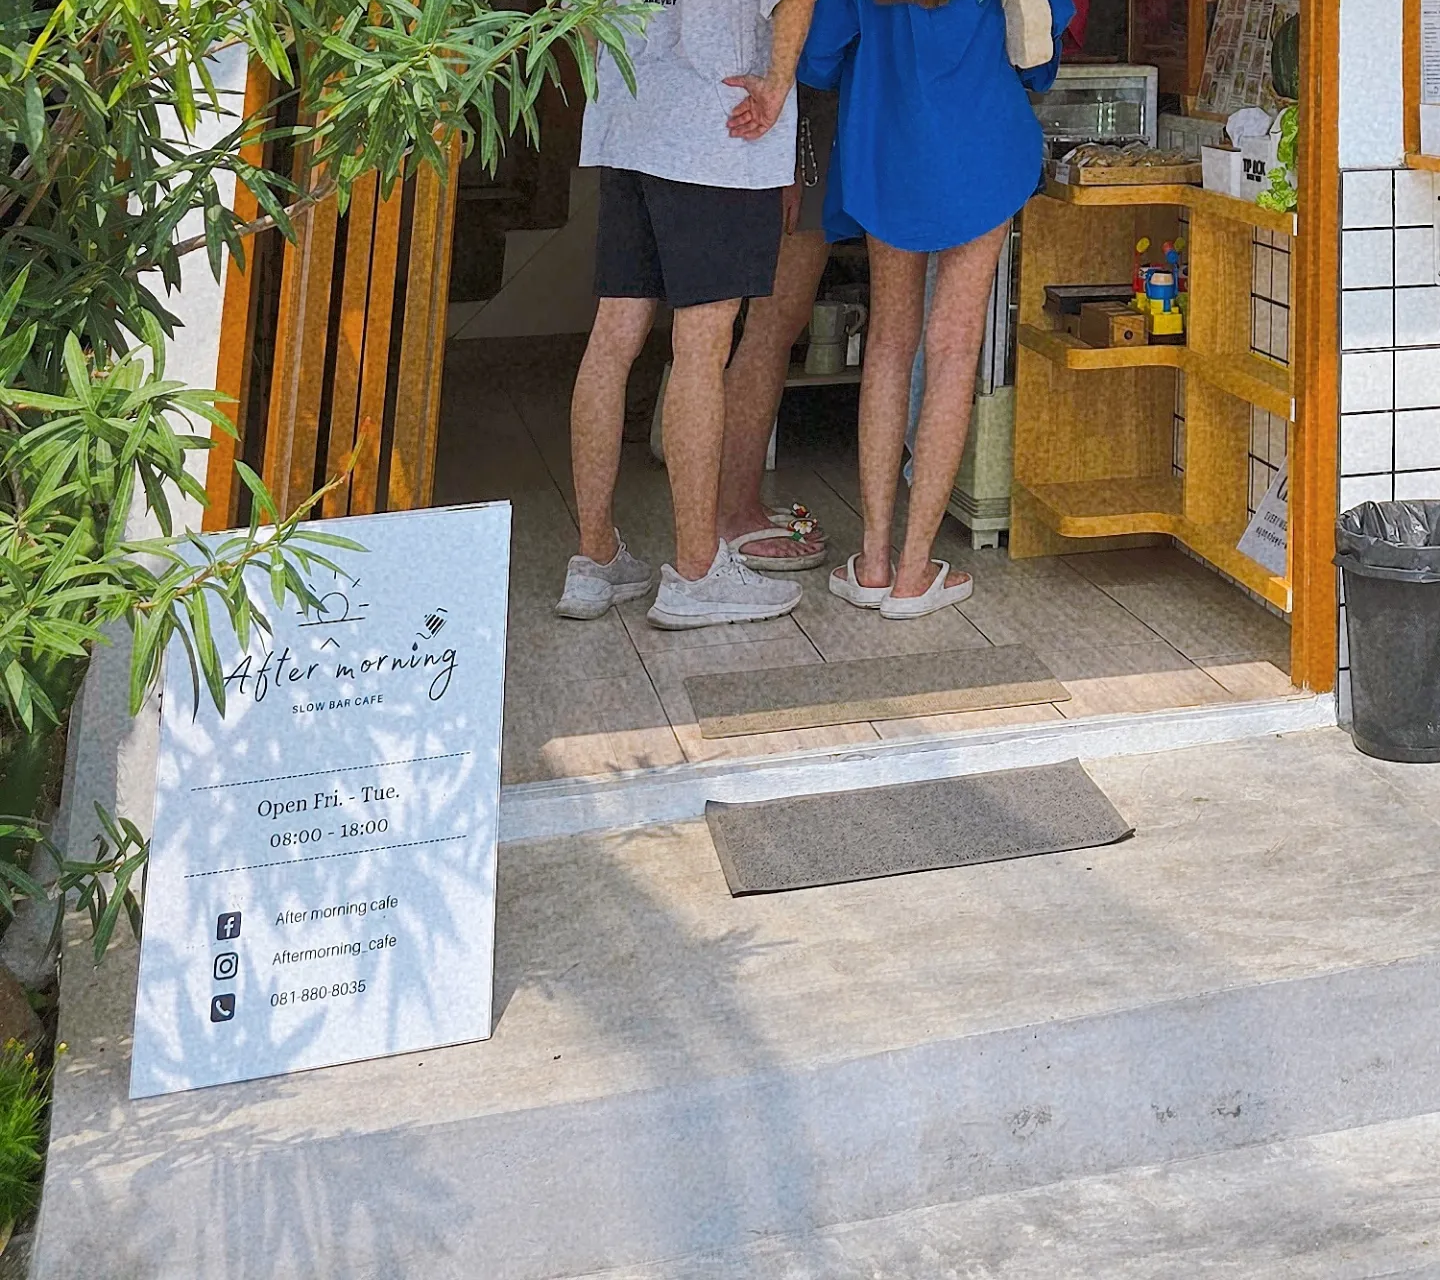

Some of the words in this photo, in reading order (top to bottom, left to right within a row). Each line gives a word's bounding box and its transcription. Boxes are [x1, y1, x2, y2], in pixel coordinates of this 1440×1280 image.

[225, 647, 319, 702] After
[335, 647, 459, 702] morning
[292, 701, 326, 714] SLOW
[328, 698, 351, 710] BAR
[354, 694, 384, 707] CAFE
[257, 799, 307, 820] Open
[313, 789, 343, 810] Fri.
[361, 786, 400, 803] Tue.
[270, 828, 322, 848] 08:00
[340, 818, 389, 839] 18:00
[275, 910, 307, 925] After
[310, 902, 367, 920] morning
[370, 895, 398, 911] cafe
[272, 934, 397, 966] Aftermorning_cafe
[270, 979, 367, 1008] 081-880-8035
